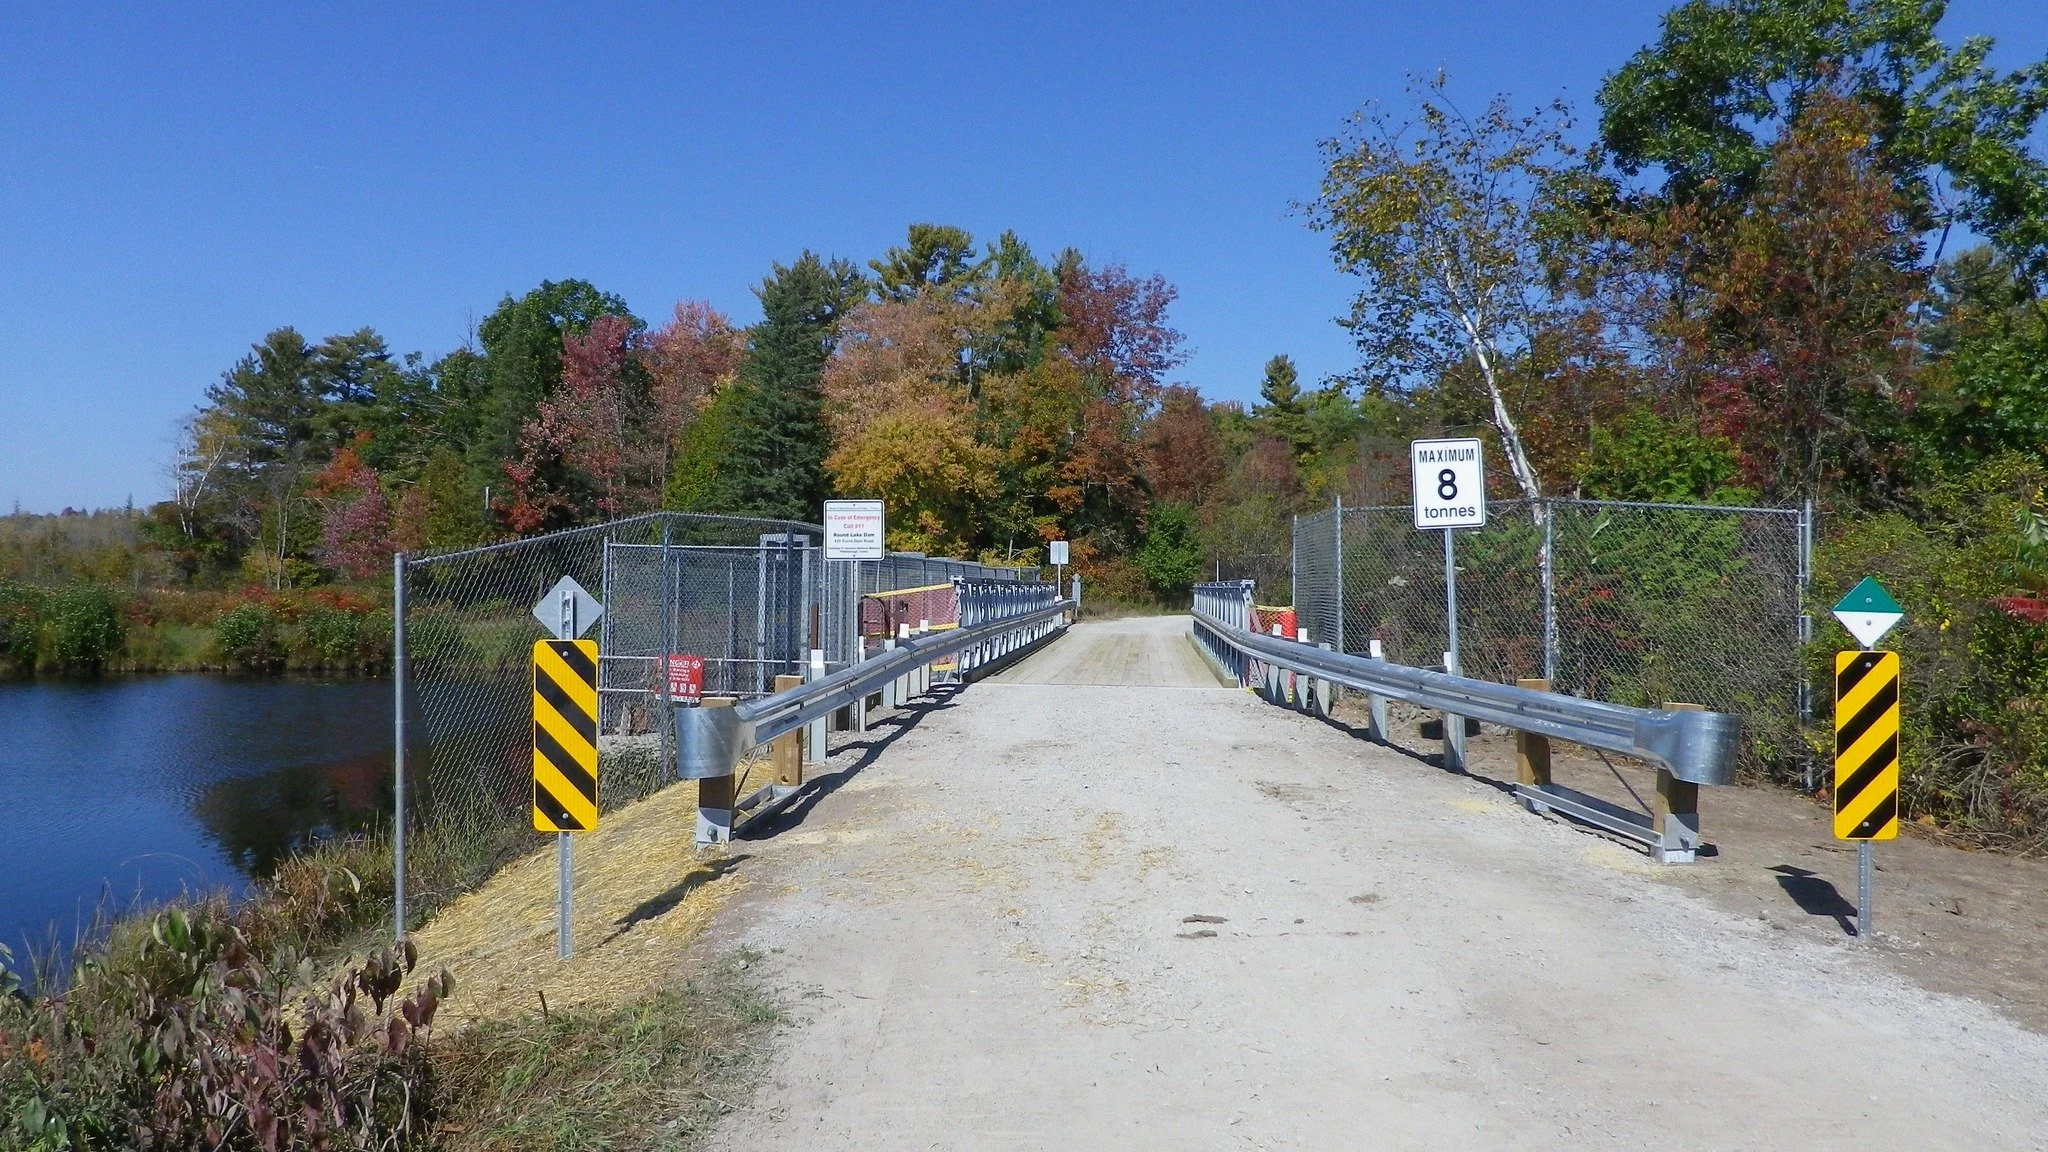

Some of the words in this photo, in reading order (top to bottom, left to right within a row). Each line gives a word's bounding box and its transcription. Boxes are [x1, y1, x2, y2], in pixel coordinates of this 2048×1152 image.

[1419, 449, 1474, 463] MAXIMUM
[1438, 468, 1457, 500] 8
[1425, 506, 1475, 518] tonnes
